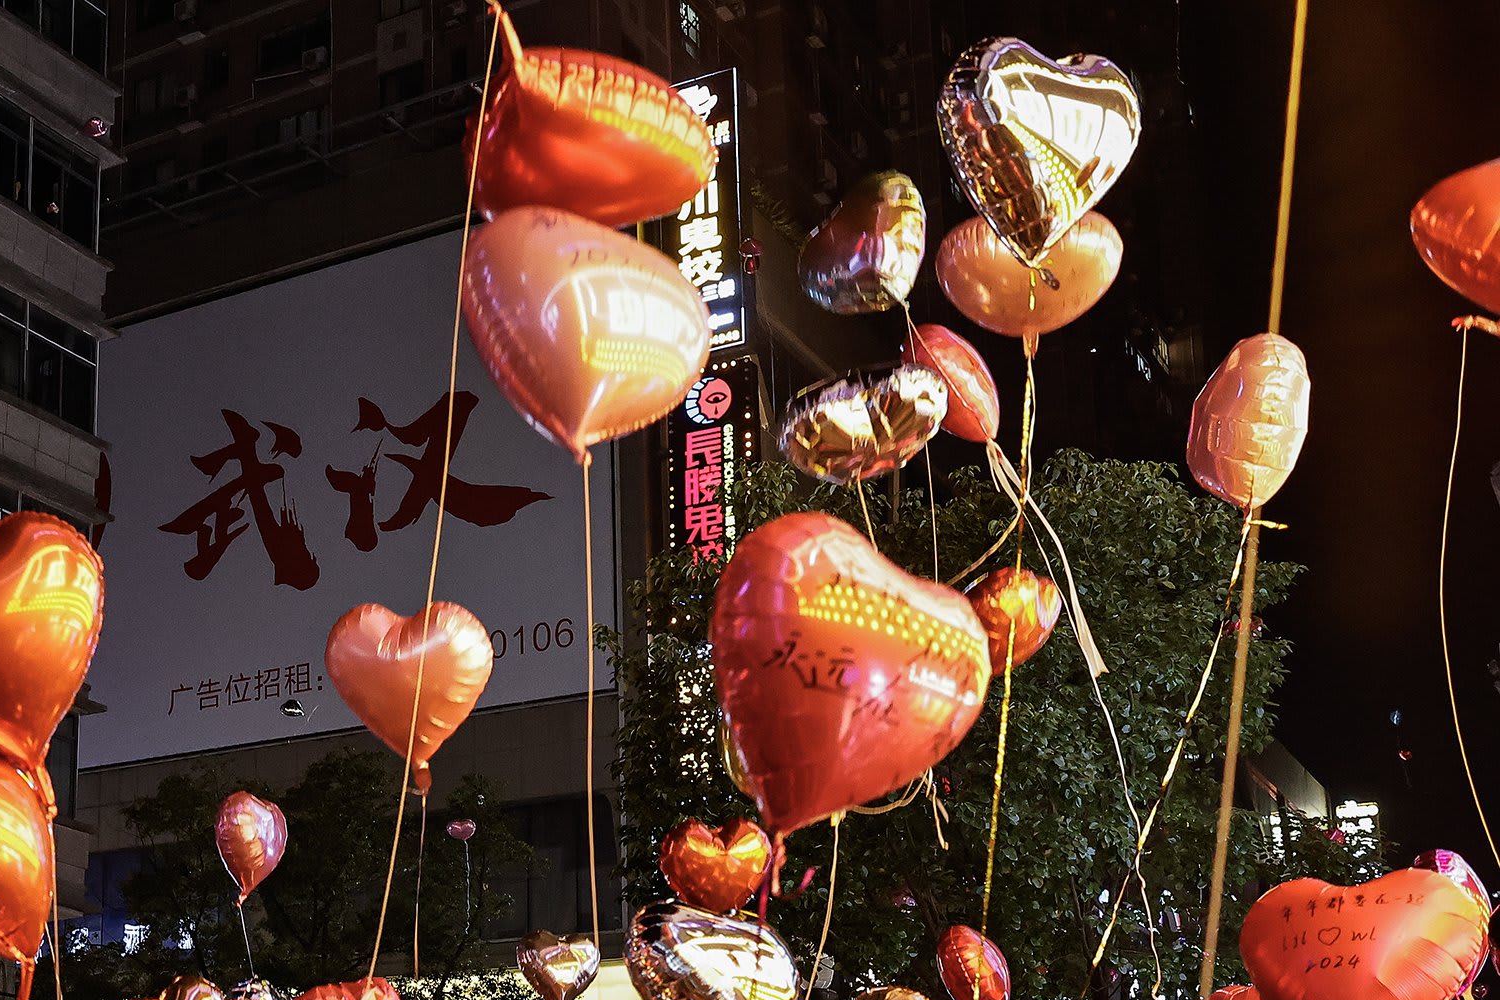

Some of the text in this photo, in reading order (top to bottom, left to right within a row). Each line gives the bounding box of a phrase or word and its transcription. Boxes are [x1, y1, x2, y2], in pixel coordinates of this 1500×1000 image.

[677, 158, 723, 289] 川鬼校
[723, 423, 734, 460] GHOST
[92, 390, 556, 591] 武汉
[1304, 953, 1360, 975] 2024
